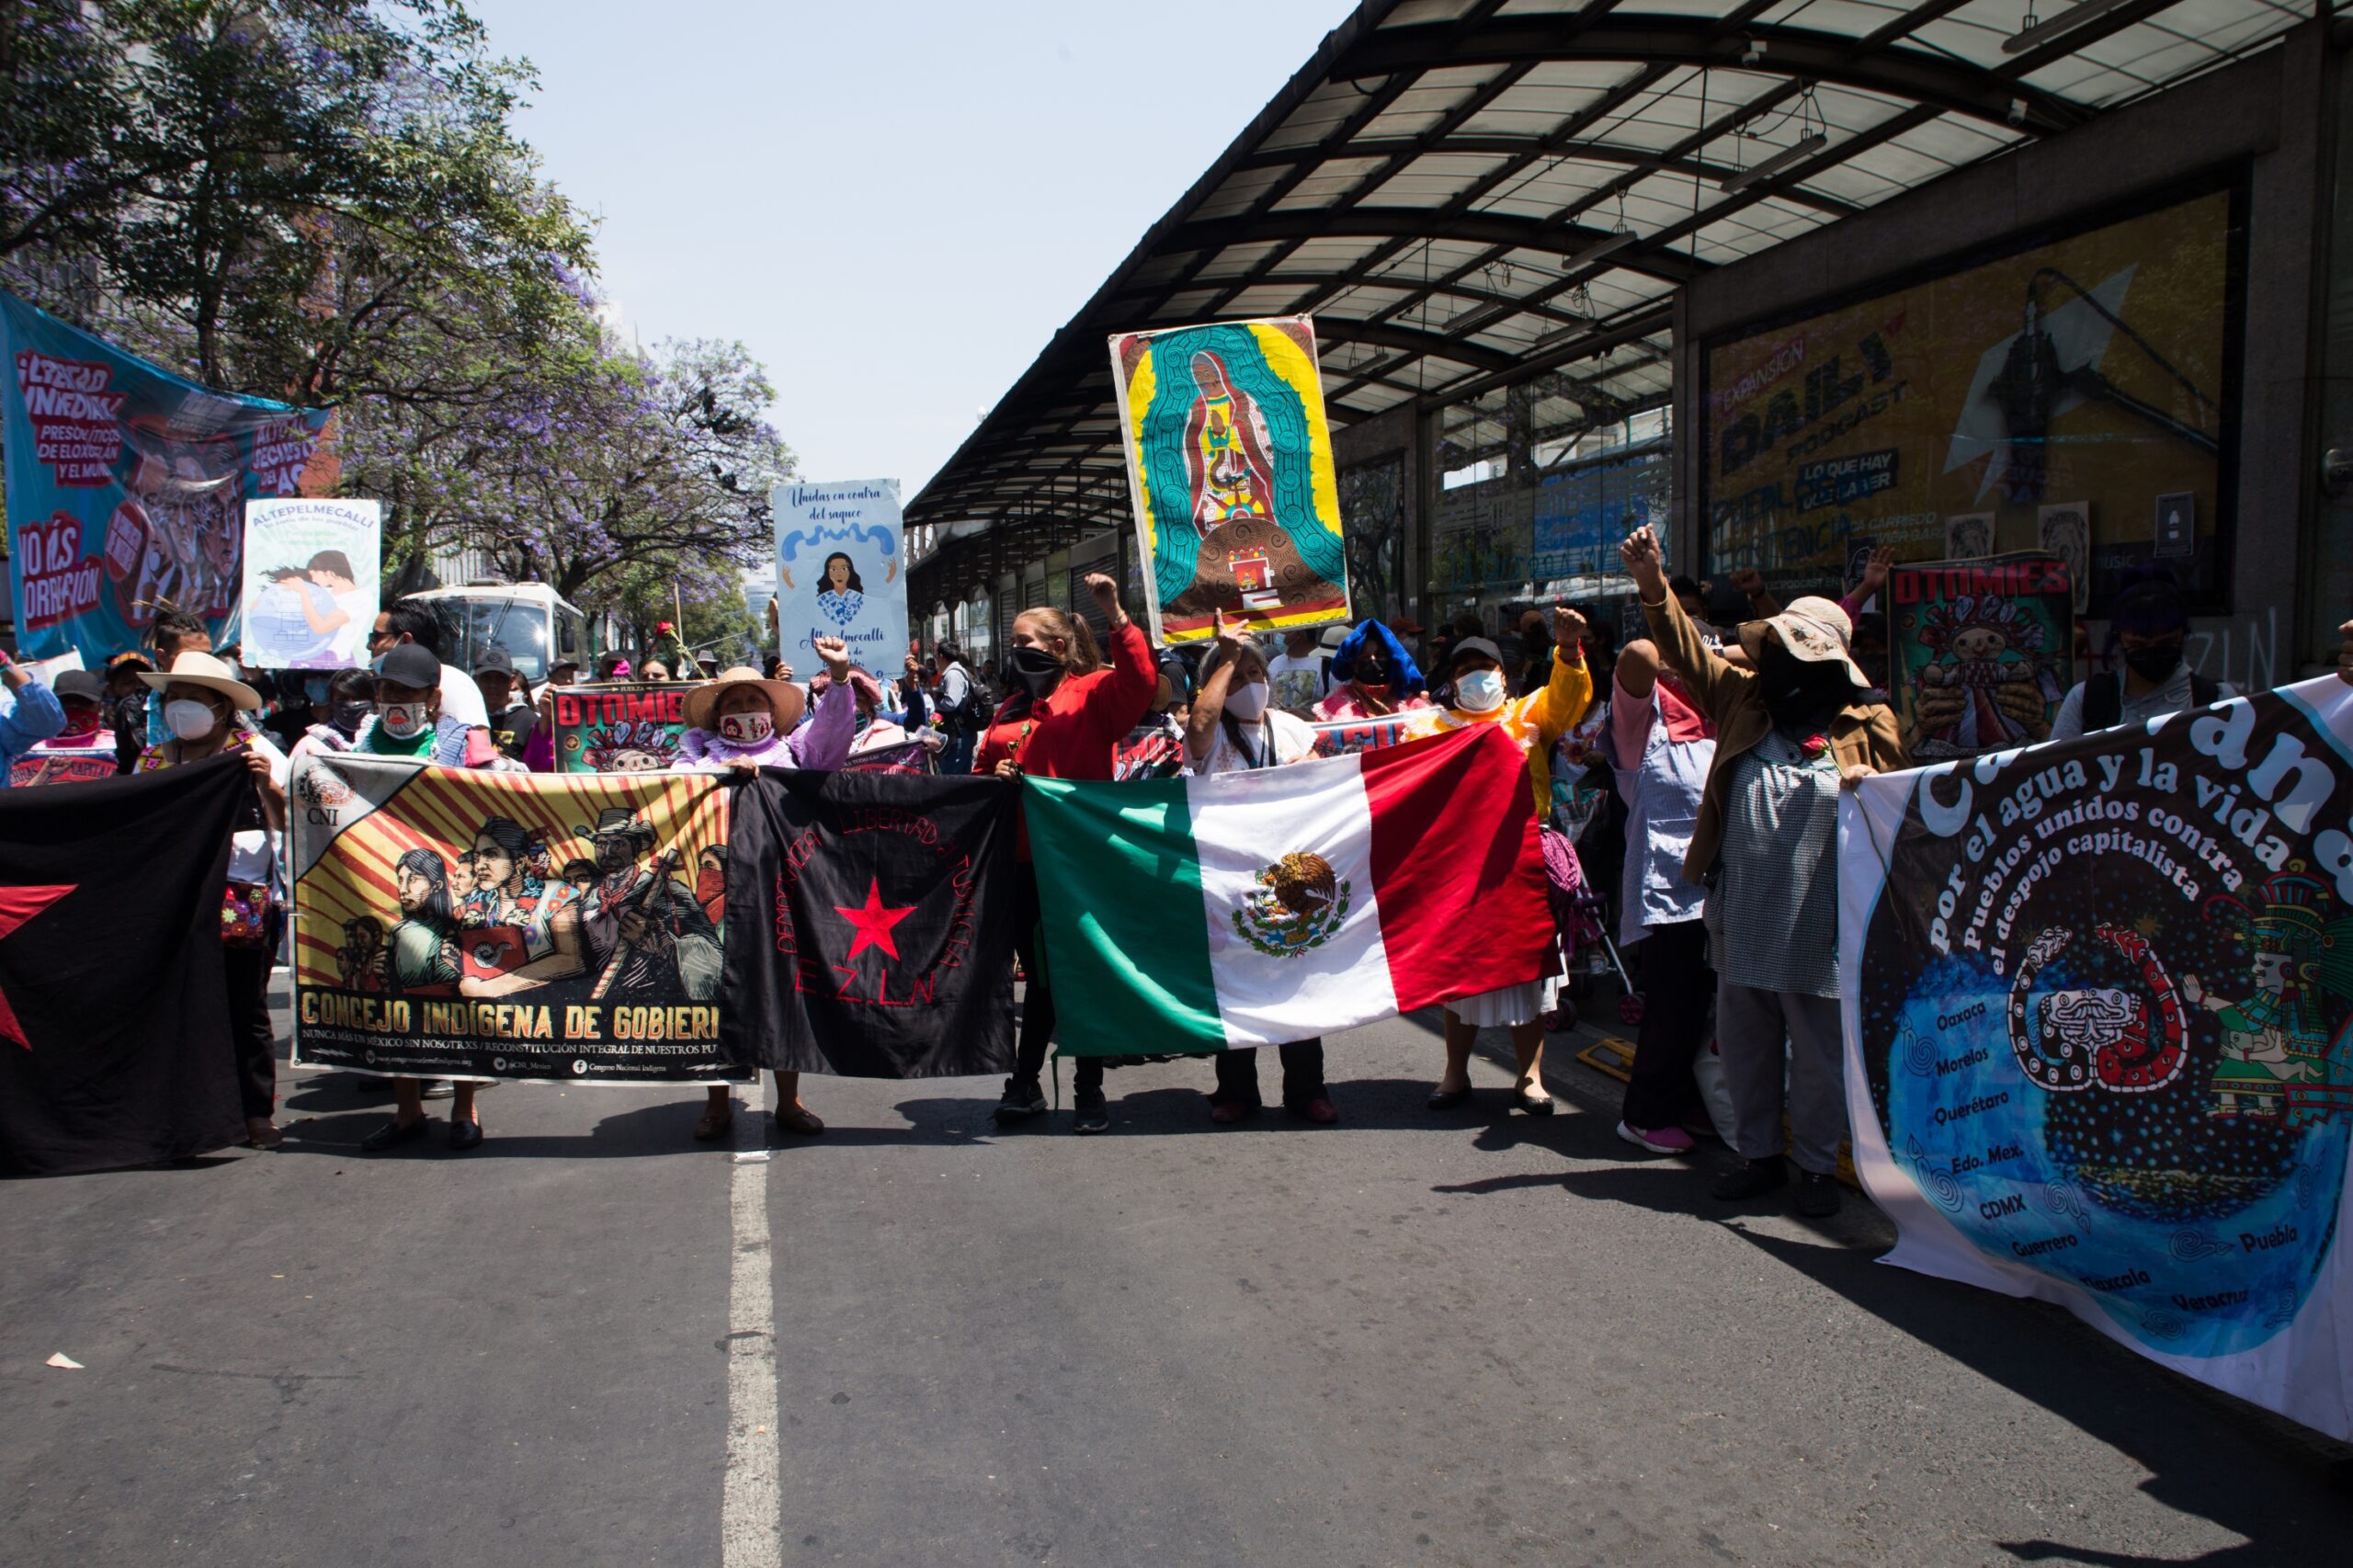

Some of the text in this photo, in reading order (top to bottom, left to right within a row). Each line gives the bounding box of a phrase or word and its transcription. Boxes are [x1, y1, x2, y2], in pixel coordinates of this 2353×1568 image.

[68, 464, 80, 478] EL
[1804, 452, 1893, 481] LO QUE HAY
[788, 485, 881, 507] Unidas en contra
[253, 505, 374, 528] ALTEPELMECALLI
[810, 506, 825, 521] del
[307, 807, 338, 826] CNI
[1930, 747, 2290, 955] por el agua y la vida
[1964, 795, 2243, 951] Pueblos unidos contra
[1991, 827, 2200, 975] el despojo capitalista
[301, 992, 412, 1034] CONCEJO
[423, 1000, 553, 1040] INDÍGENA
[564, 1005, 602, 1040] DE
[1937, 1001, 1986, 1031] Oaxaca
[302, 1029, 337, 1040] NUNCA
[354, 1034, 366, 1044] UN
[367, 1036, 404, 1049] MÉXICO
[404, 1039, 420, 1048] SIN
[422, 1039, 478, 1050] NOSOTRXS
[484, 1041, 576, 1054] RECONSTITUCIÓN
[579, 1044, 630, 1055] INTEGRAL
[631, 1044, 644, 1055] DE
[645, 1044, 699, 1055] NUESTROS
[1936, 1047, 1989, 1076] Morelos
[1934, 1091, 2009, 1126] Querétaro
[1951, 1145, 2025, 1175] Edo. Mex.
[1979, 1194, 2027, 1221] CDMX
[2011, 1233, 2078, 1257] Guerrero
[2238, 1223, 2298, 1254] Puebla
[2171, 1289, 2250, 1312] Veracruz
